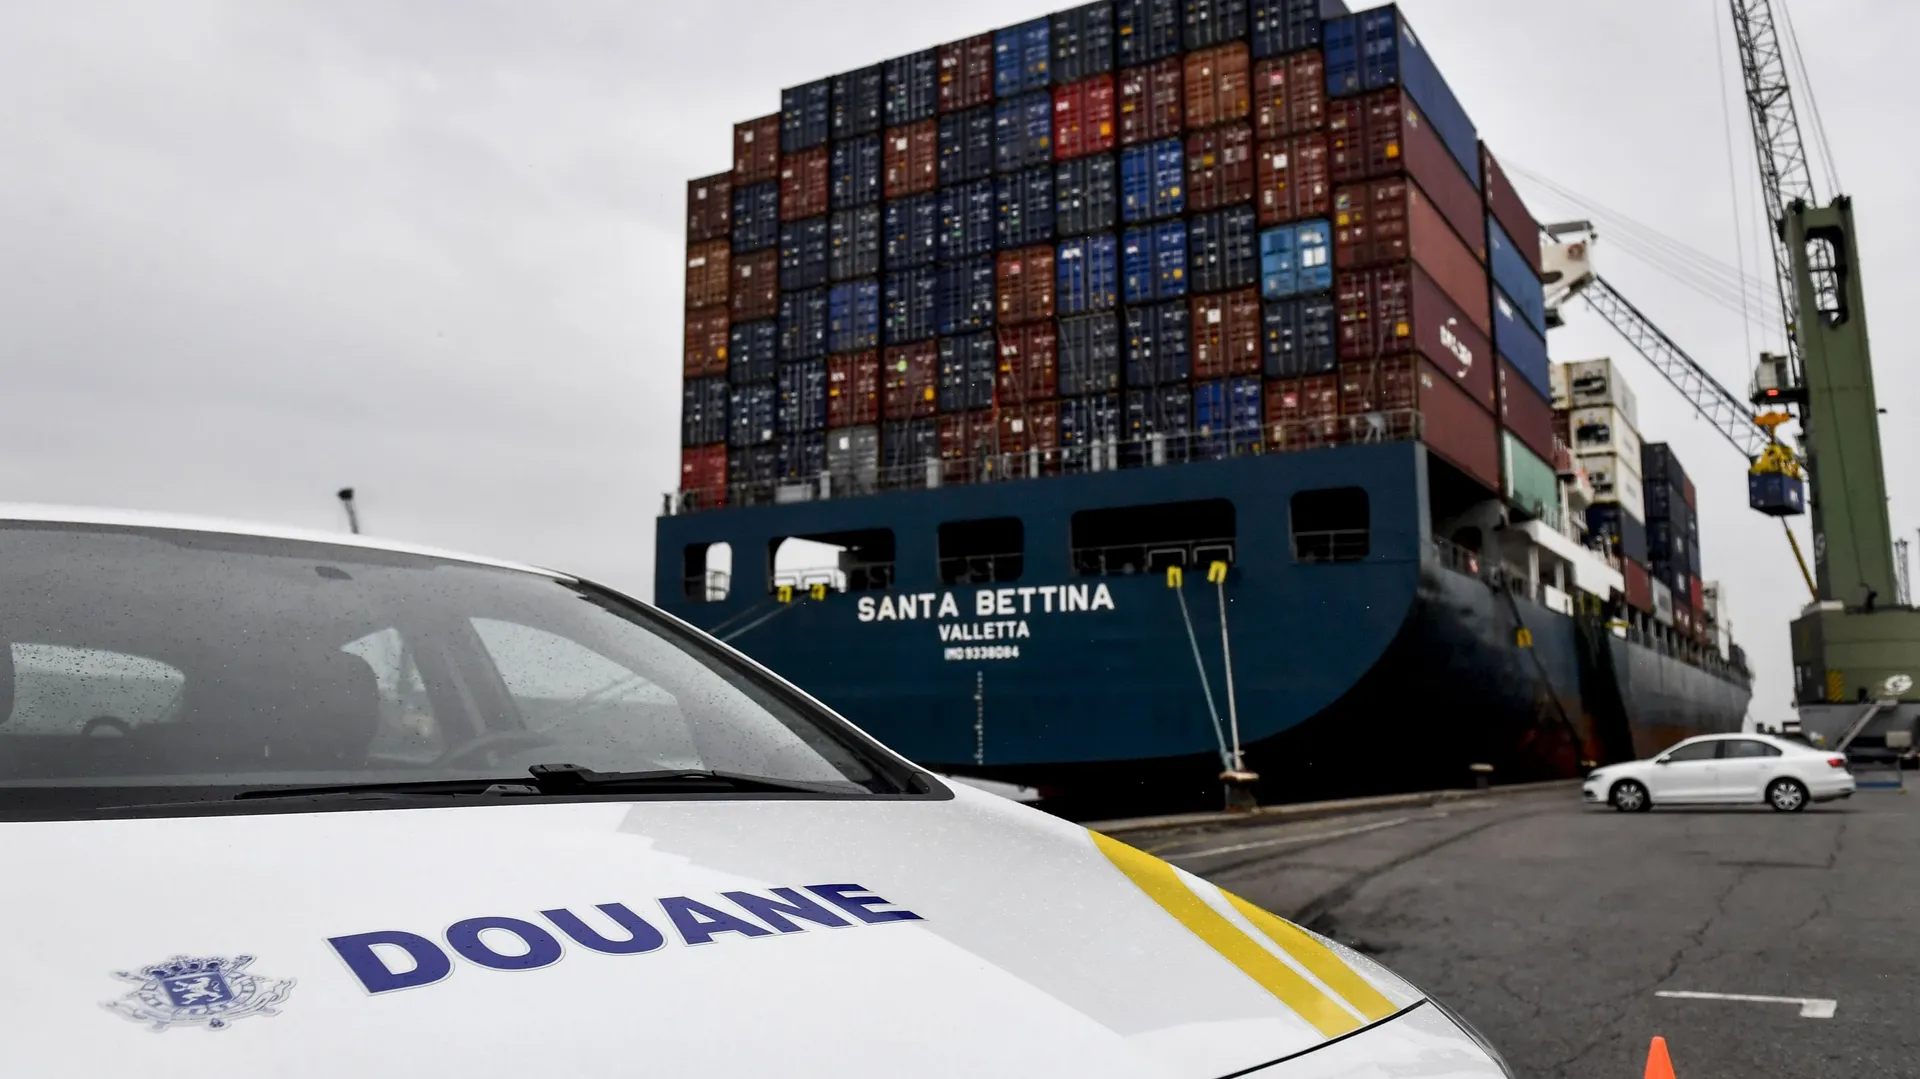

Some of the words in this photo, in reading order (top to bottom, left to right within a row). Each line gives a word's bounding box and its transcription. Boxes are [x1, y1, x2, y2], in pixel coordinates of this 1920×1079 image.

[857, 591, 959, 621] SANTA
[976, 583, 1115, 616] BETTINA
[938, 620, 1030, 642] VALLETTA
[326, 882, 926, 995] DOUANE
